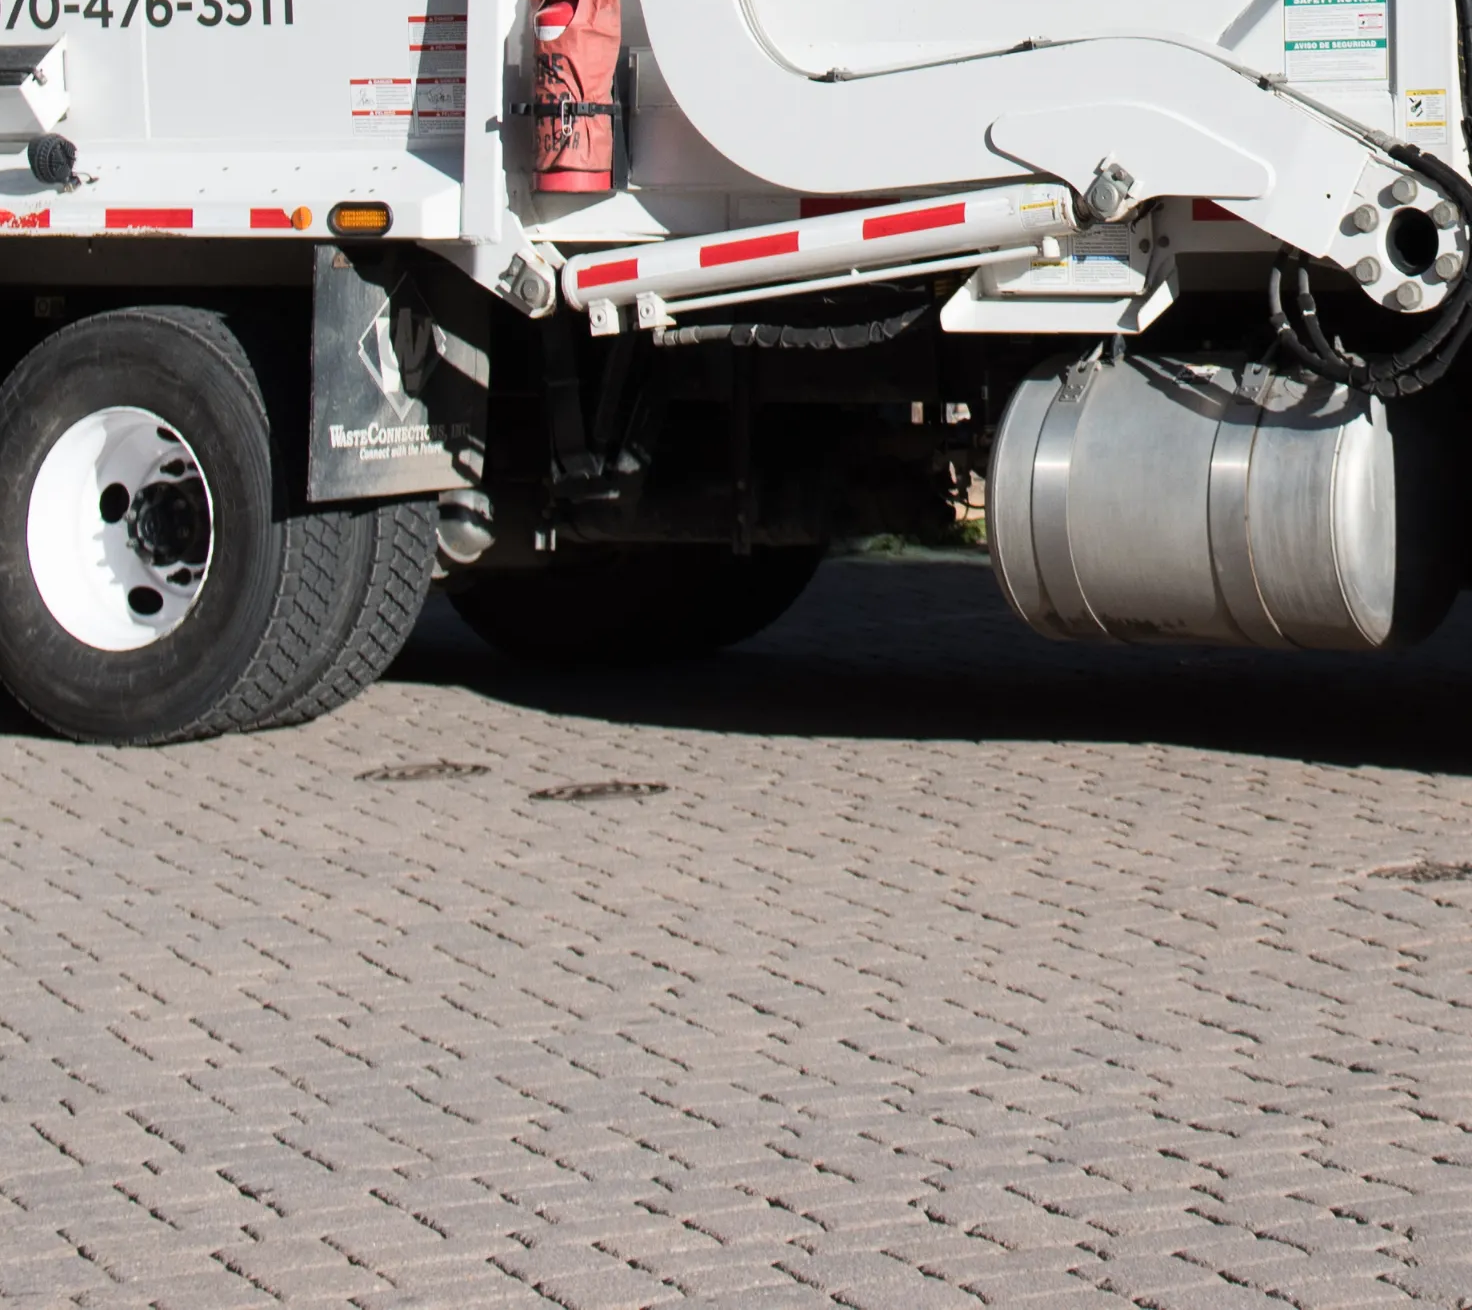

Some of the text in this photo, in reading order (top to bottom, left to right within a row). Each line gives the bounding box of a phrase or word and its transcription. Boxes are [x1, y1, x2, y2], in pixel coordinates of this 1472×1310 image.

[1294, 40, 1377, 50] AVISO DE SEGURIDAD
